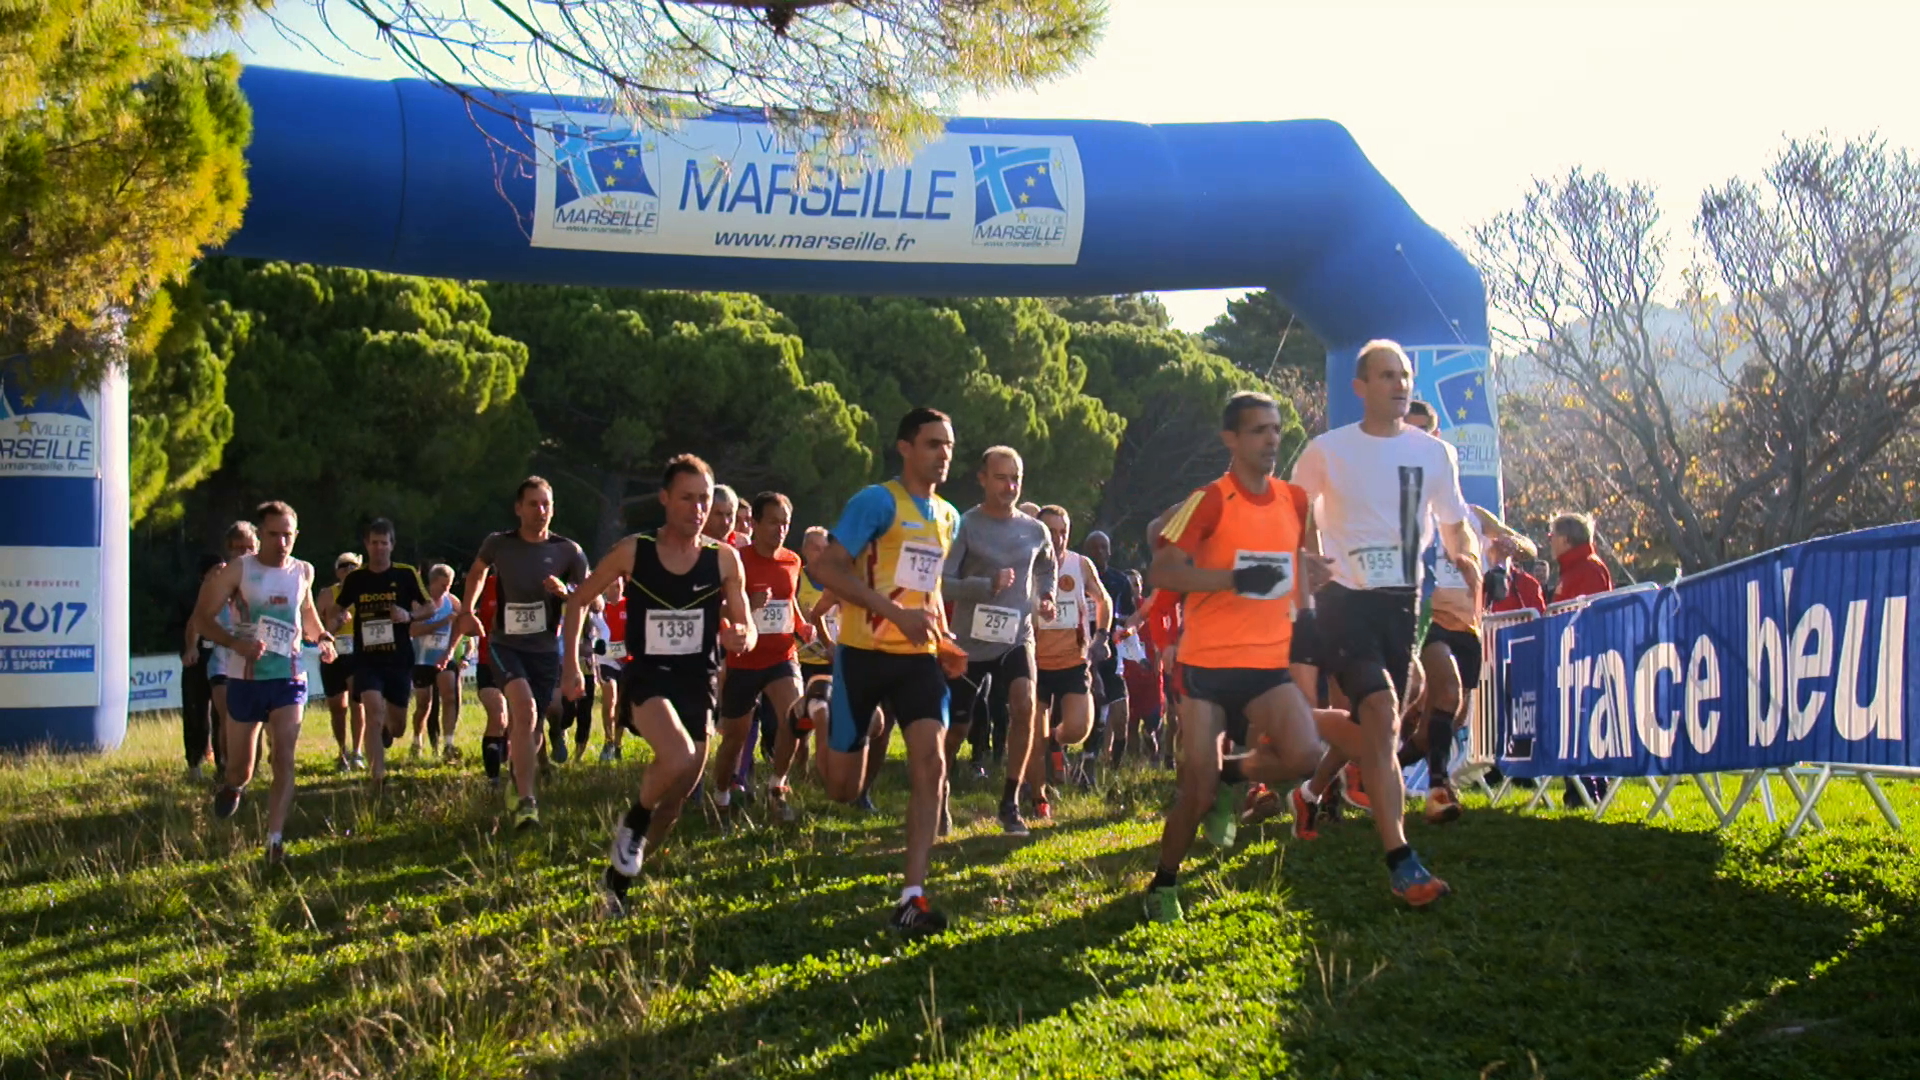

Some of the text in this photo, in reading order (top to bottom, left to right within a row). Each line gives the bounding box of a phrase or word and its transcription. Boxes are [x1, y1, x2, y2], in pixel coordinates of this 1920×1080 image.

[678, 159, 957, 220] MARSEILLE
[556, 208, 657, 228] MARSEILLE
[975, 224, 1064, 240] MARSEILLE
[714, 230, 915, 252] www.marseille.fr
[36, 423, 91, 438] VILLE DE
[1358, 552, 1394, 570] 1955
[0, 599, 87, 634] 2017
[515, 610, 536, 623] 236
[763, 608, 783, 621] 295
[984, 614, 1009, 630] 257
[657, 621, 694, 638] 1338
[11, 646, 92, 659] EUROPÉENNE
[12, 660, 55, 671] SPORT
[135, 669, 173, 686] 2017
[1511, 696, 1536, 735] bleu
